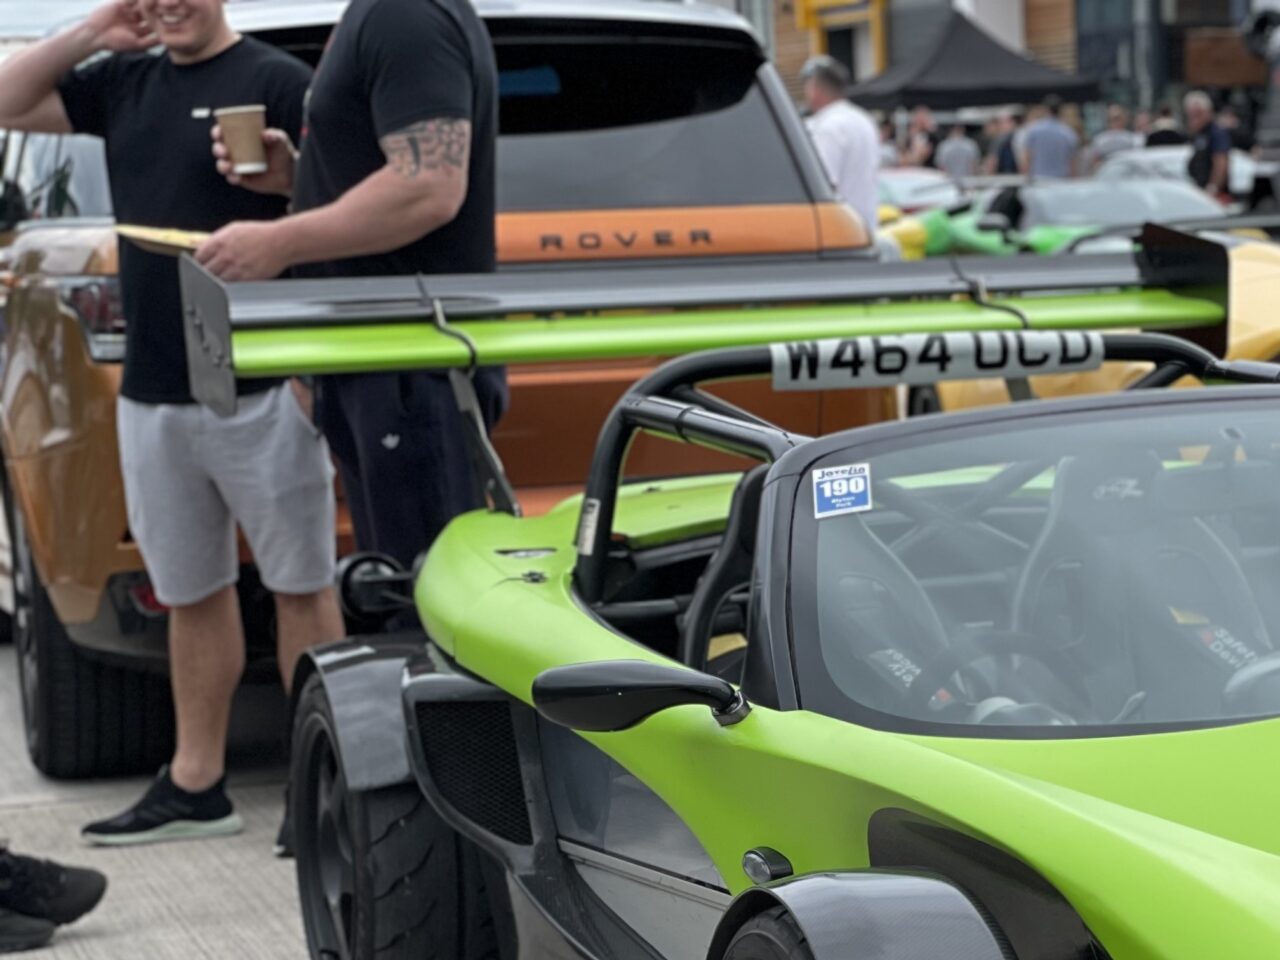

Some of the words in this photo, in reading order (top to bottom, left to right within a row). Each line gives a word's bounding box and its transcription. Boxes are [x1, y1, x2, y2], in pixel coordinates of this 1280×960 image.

[540, 229, 711, 250] ROVER
[786, 333, 952, 381] W464
[819, 476, 865, 498] 190
